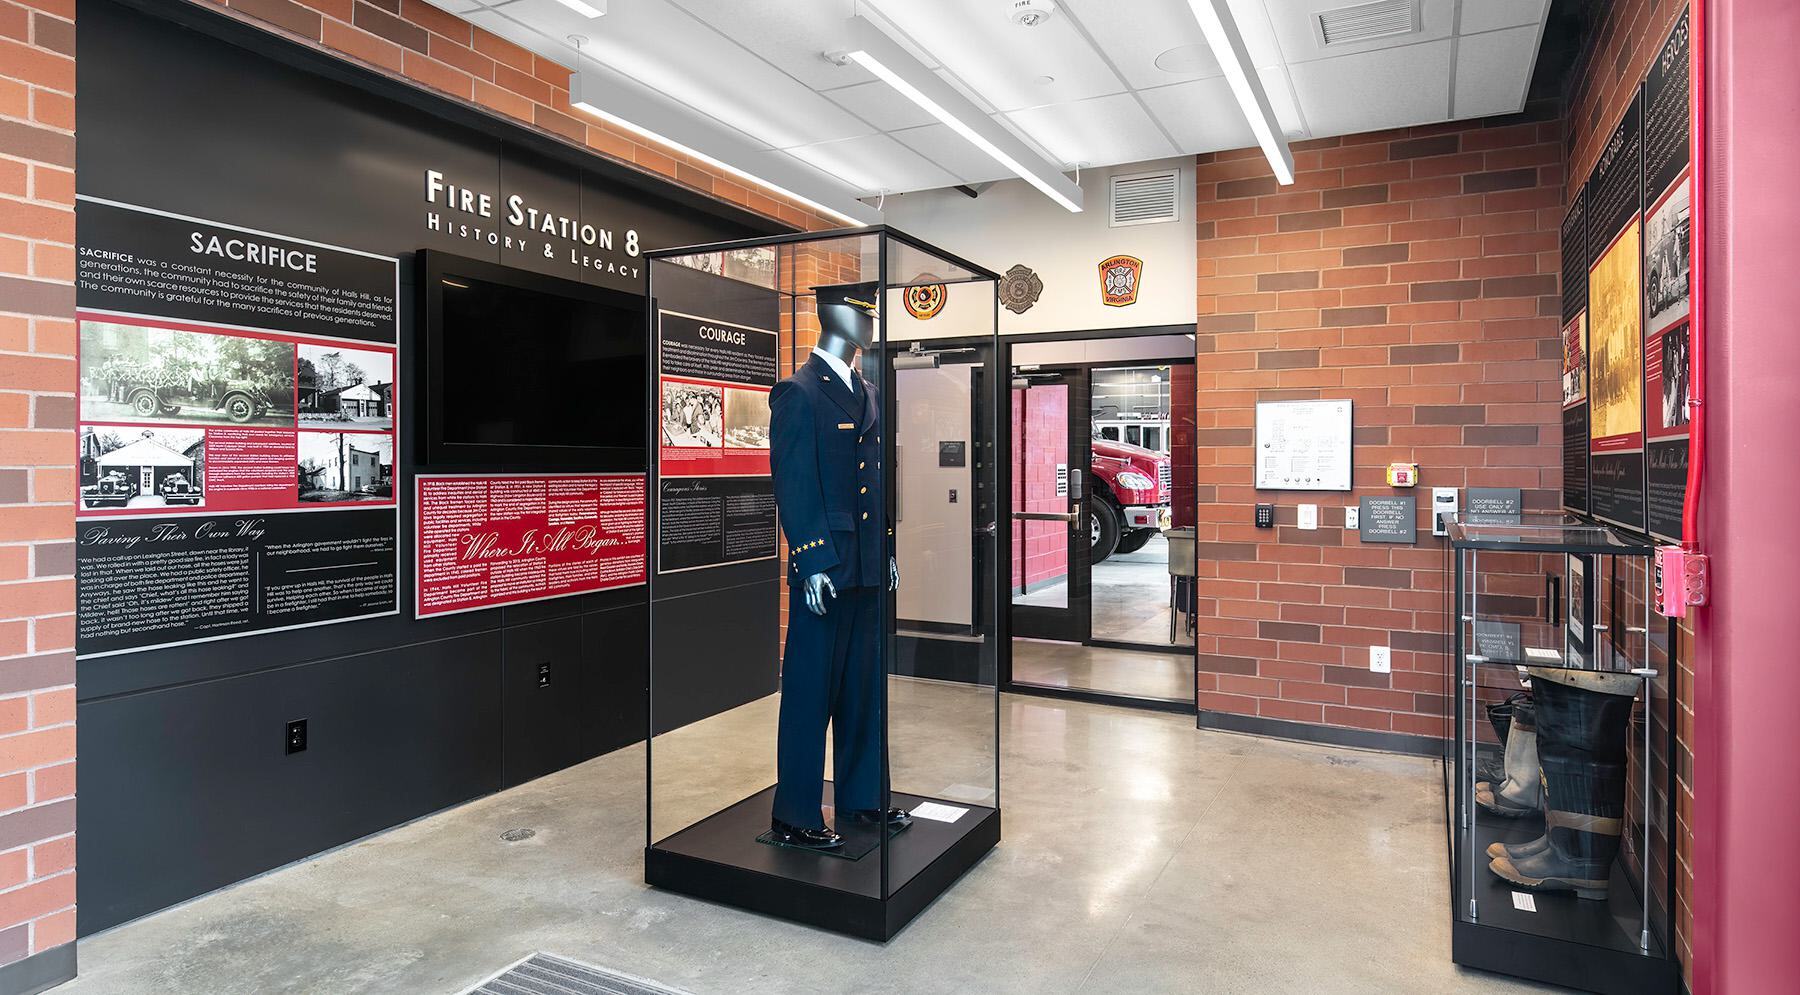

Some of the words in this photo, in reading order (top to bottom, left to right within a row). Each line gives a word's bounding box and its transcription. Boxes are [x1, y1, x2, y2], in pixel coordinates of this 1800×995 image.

[1014, 0, 1031, 8] FIRE
[426, 169, 491, 218] FIRE
[506, 194, 613, 250] STATION
[624, 230, 640, 258] 8
[190, 232, 317, 273] SACRIFICE
[427, 212, 526, 252] HISTORY
[543, 244, 554, 258] &
[571, 249, 638, 279] LEGACY
[1102, 258, 1140, 270] ARLINGTON
[79, 247, 133, 263] SACRIFICE
[137, 258, 156, 266] was
[171, 262, 211, 275] constant
[214, 269, 253, 283] necessity
[256, 276, 267, 284] for
[271, 278, 283, 286] the
[286, 280, 329, 294] community
[341, 290, 357, 298] Halls
[360, 292, 371, 301] Hill,
[79, 258, 141, 276] generations,
[144, 268, 158, 277] the
[160, 271, 210, 286] community
[212, 278, 229, 287] had
[240, 283, 273, 294] sacrifice
[288, 290, 310, 301] safety
[320, 295, 334, 303] their
[336, 298, 356, 308] family
[372, 303, 392, 312] friends
[79, 269, 100, 279] and
[102, 273, 123, 282] their
[124, 277, 145, 286] own
[146, 280, 177, 290] scarce
[178, 285, 219, 296] resources
[229, 291, 260, 303] provide
[261, 295, 274, 303] the
[275, 297, 303, 308] services
[304, 301, 318, 310] that
[332, 305, 360, 315] residents
[361, 310, 392, 320] deserved.
[79, 280, 97, 290] The
[100, 283, 156, 298] community
[166, 292, 201, 304] grateful
[203, 296, 214, 305] for
[216, 298, 230, 307] the
[232, 302, 255, 312] many
[257, 304, 292, 315] sacrifices
[302, 310, 332, 322] previous
[334, 314, 376, 328] generations.
[699, 326, 746, 346] COURAGE
[80, 526, 142, 549] Paving
[144, 523, 188, 542] Their
[194, 520, 230, 540] Own
[234, 518, 266, 541] Way
[461, 532, 508, 561] Where
[510, 528, 536, 556] It
[536, 526, 574, 554] All
[95, 628, 118, 638] nothing
[132, 623, 170, 632] secondhand
